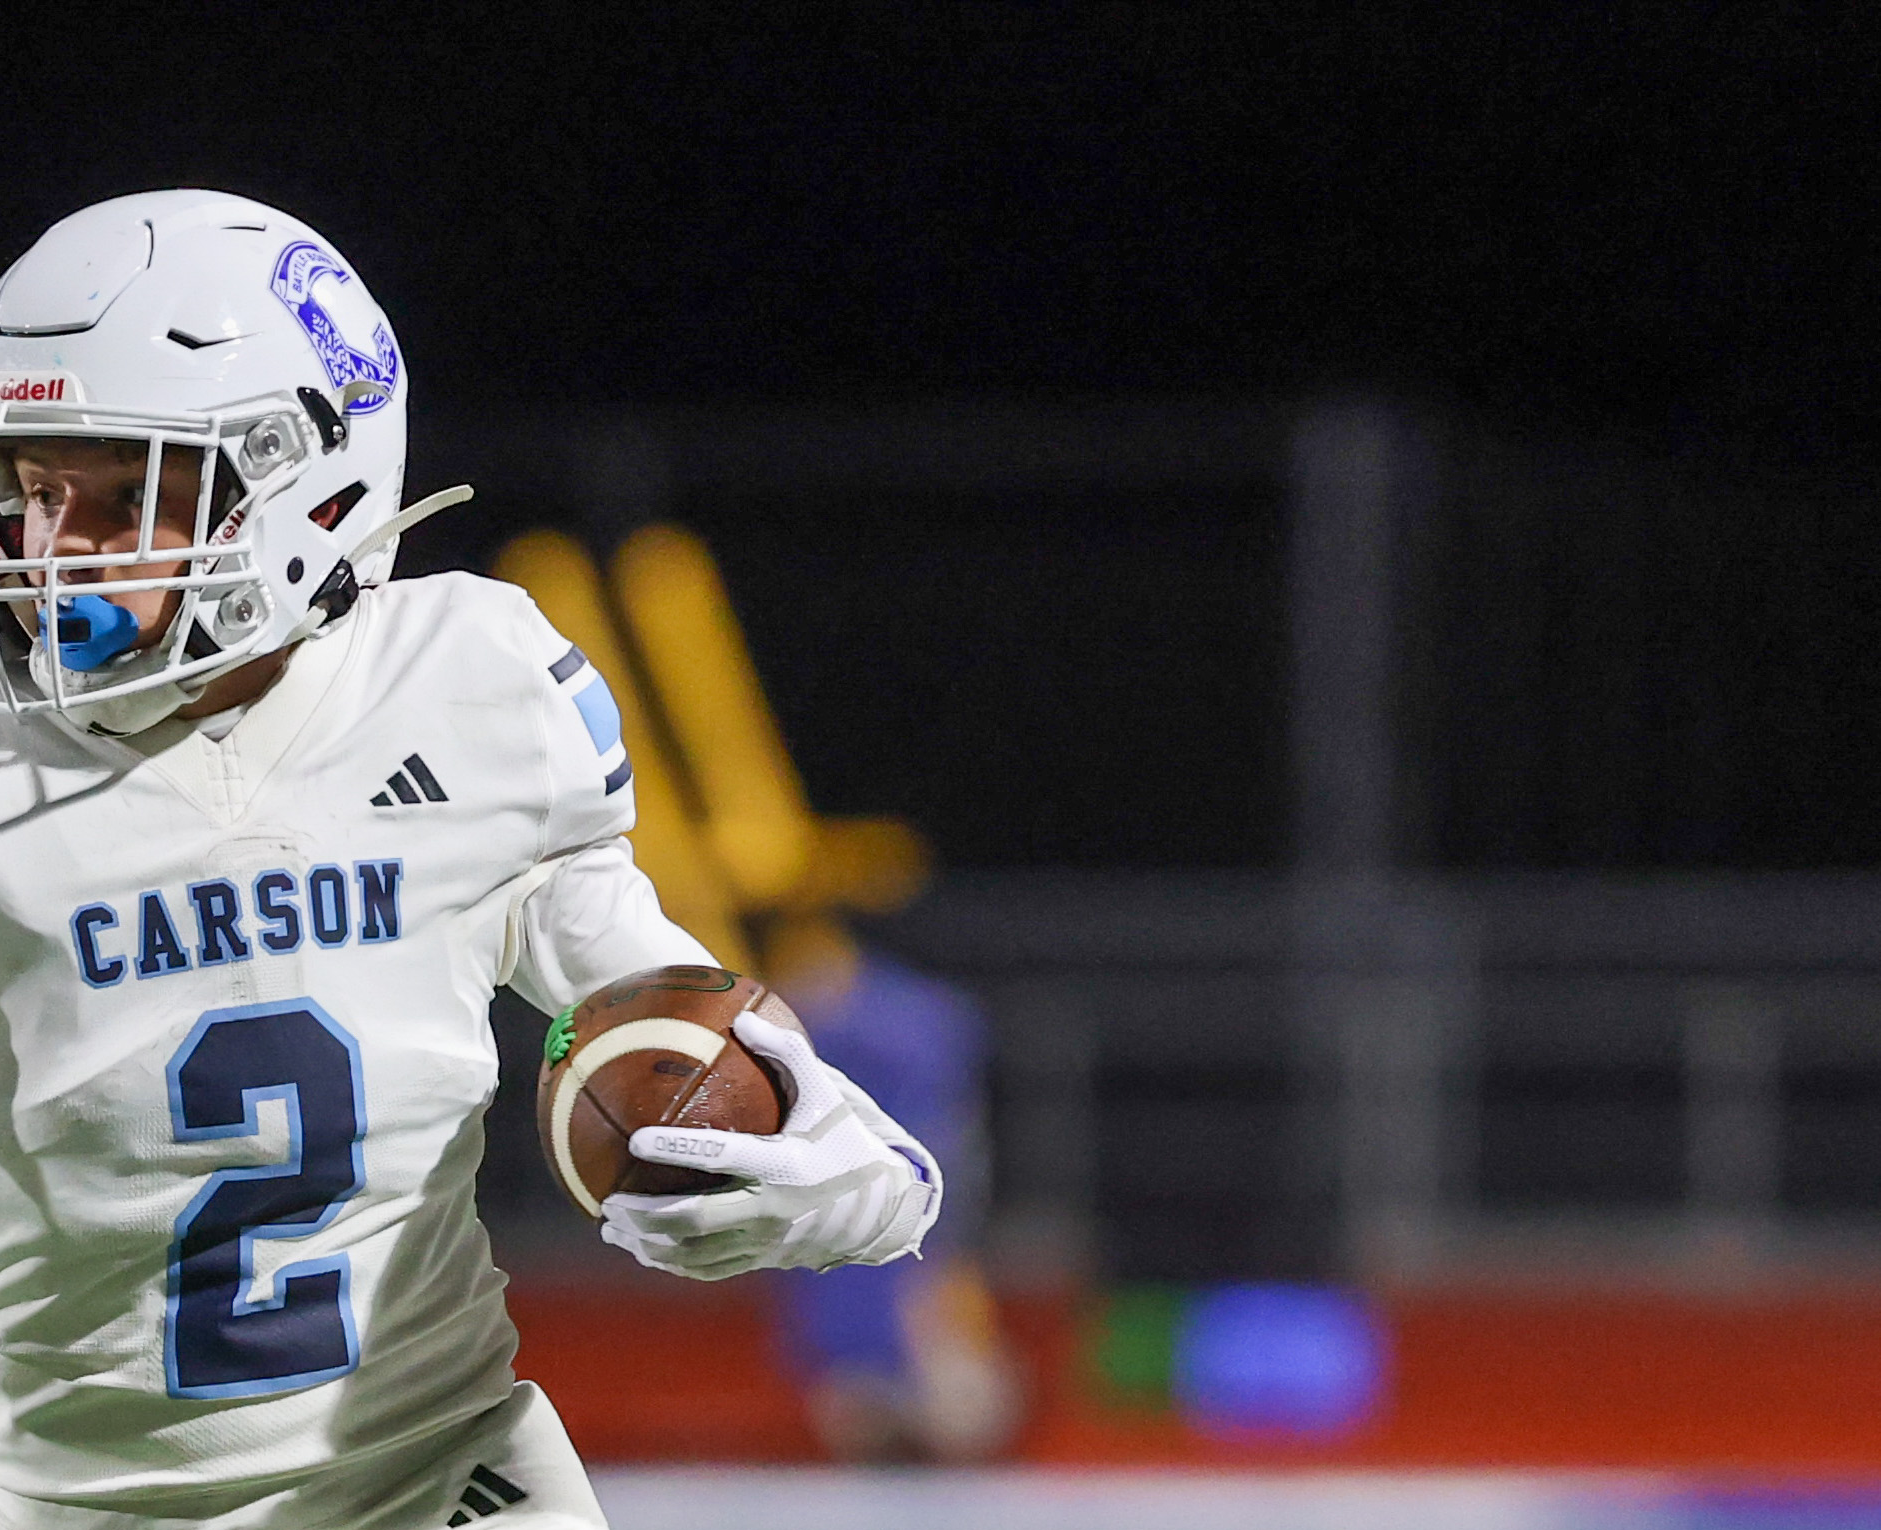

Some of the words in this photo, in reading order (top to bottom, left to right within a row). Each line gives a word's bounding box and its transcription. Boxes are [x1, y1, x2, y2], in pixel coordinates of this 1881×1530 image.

[292, 253, 308, 294] BATTLE
[70, 858, 404, 990] CARSON
[164, 996, 367, 1399] 2
